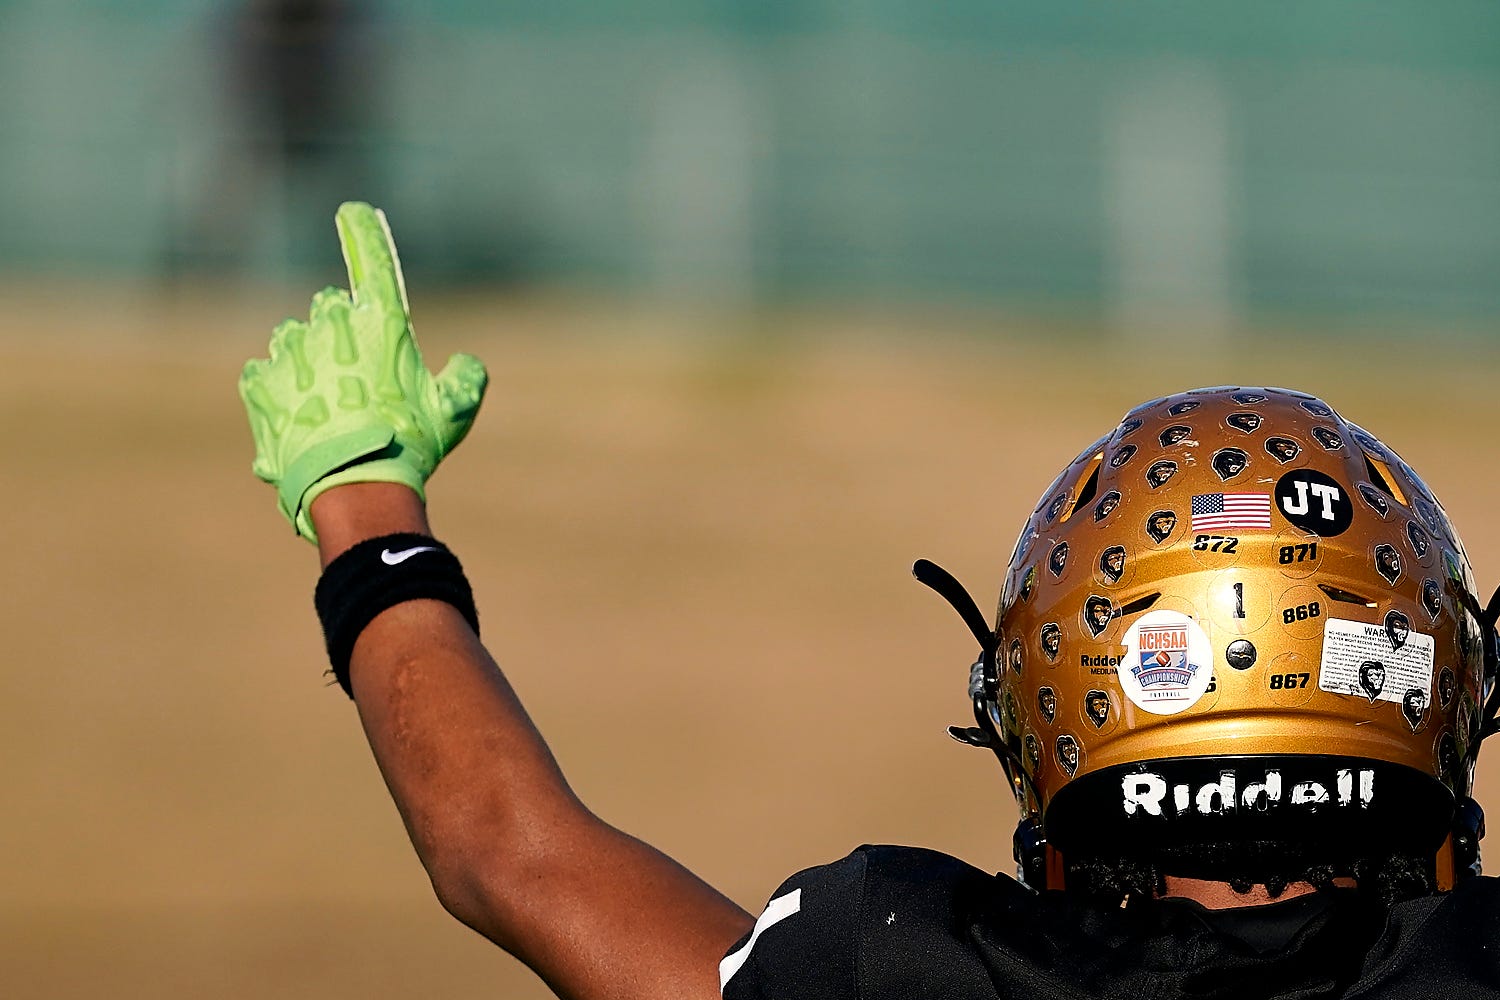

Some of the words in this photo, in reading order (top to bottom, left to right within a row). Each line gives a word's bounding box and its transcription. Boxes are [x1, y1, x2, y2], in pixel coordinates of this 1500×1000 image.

[1282, 480, 1340, 521] JT
[1193, 534, 1239, 554] 872
[1278, 542, 1318, 565] 871
[1233, 582, 1246, 619] 1
[1282, 602, 1321, 625] 868
[1139, 631, 1188, 650] NCHSAA
[1140, 671, 1189, 686] CHAMPIONSHIPS
[1269, 672, 1311, 690] 867
[1121, 768, 1375, 819] Riddell
